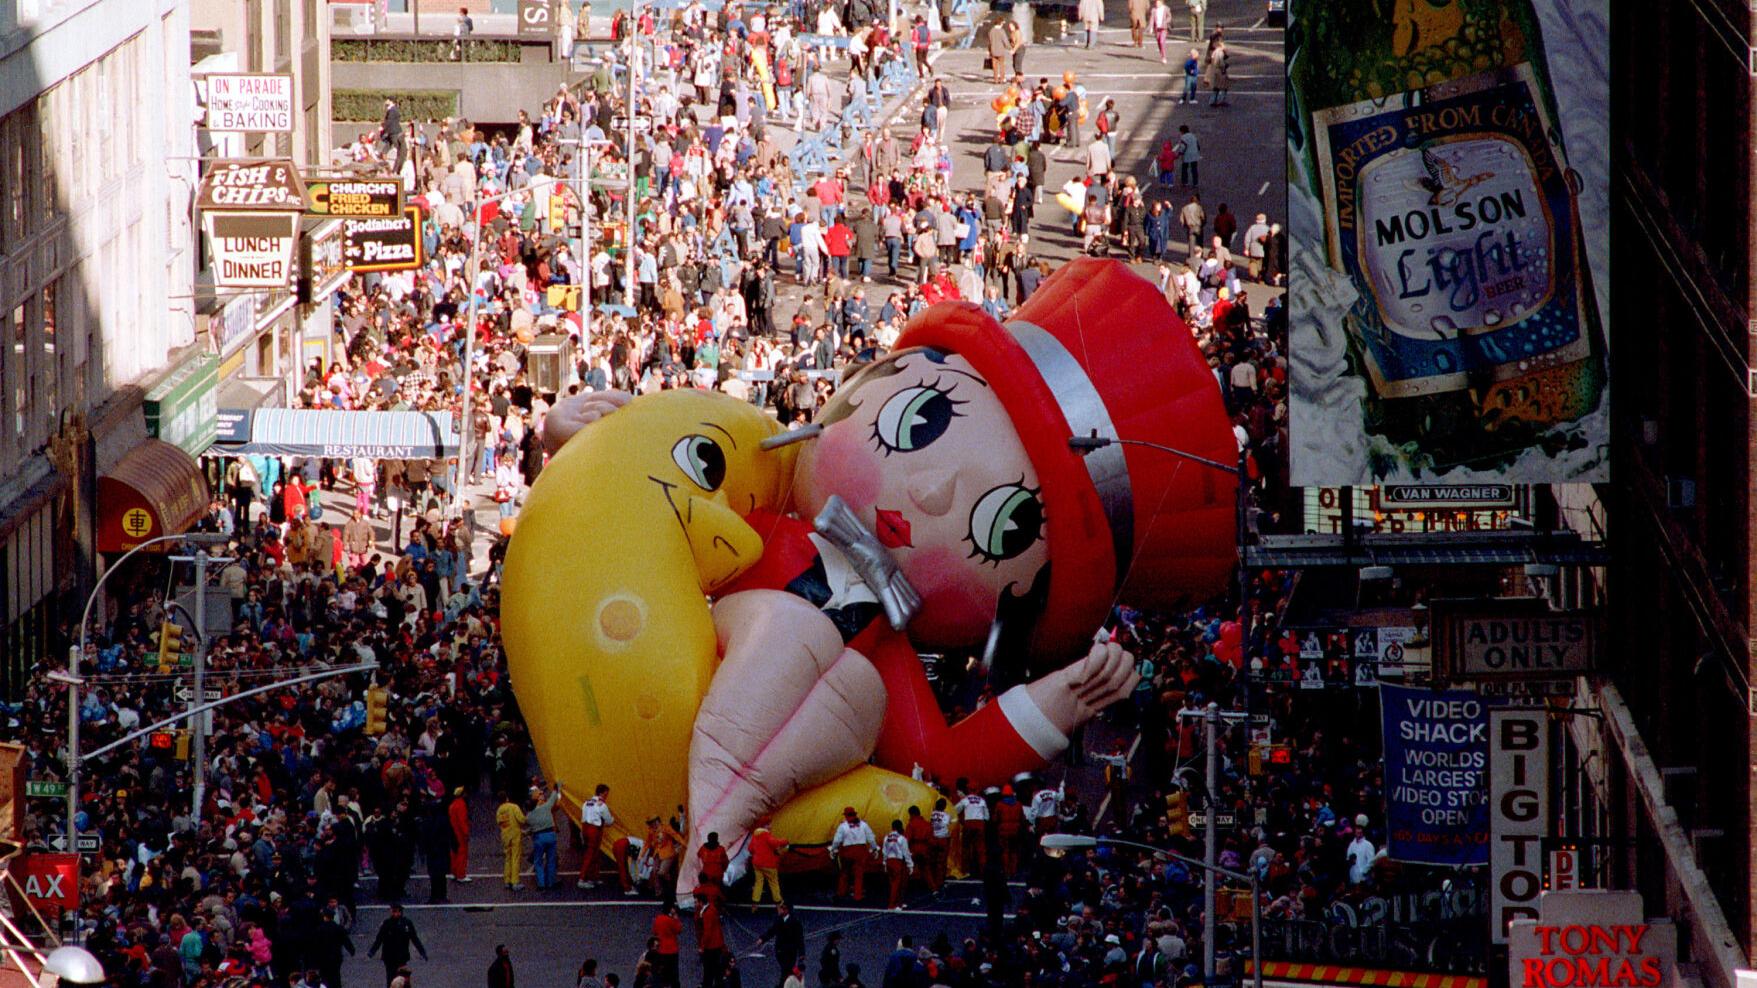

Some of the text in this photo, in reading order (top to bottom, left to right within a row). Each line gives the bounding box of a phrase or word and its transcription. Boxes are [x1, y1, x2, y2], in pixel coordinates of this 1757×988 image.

[215, 79, 284, 94] ON PARADE
[252, 96, 288, 111] COOKING
[223, 112, 287, 128] BAKING
[211, 164, 287, 186] FISH &
[1336, 125, 1397, 231] IMPORTED
[1404, 103, 1482, 134] FROM
[211, 184, 289, 205] CHIPS
[329, 183, 397, 194] CHURCH'S
[329, 194, 371, 204] FRIED
[329, 204, 390, 214] CHICKEN
[1376, 189, 1526, 246] MOLSON
[223, 237, 281, 252] LUNCH
[363, 240, 414, 261] Pizza
[223, 259, 282, 279] DINNER
[1398, 230, 1528, 312] Light
[1485, 277, 1526, 299] BEER
[323, 445, 414, 457] RESTAURANT
[1401, 487, 1501, 499] VAN WAGNER
[127, 509, 148, 537] 車
[1467, 620, 1583, 644] ADULTS
[1484, 645, 1569, 669] ONLY
[1407, 698, 1481, 720] VIDEO
[1400, 720, 1487, 744] SHACK
[1404, 748, 1486, 769] WORLDS
[1402, 767, 1487, 788] LARGEST
[1500, 719, 1540, 822] BIG
[43, 783, 56, 794] 49
[1392, 785, 1442, 807] VIDEO
[1421, 808, 1470, 826] OPEN
[1535, 925, 1650, 956] TONY
[1521, 957, 1663, 988] ROMAS
